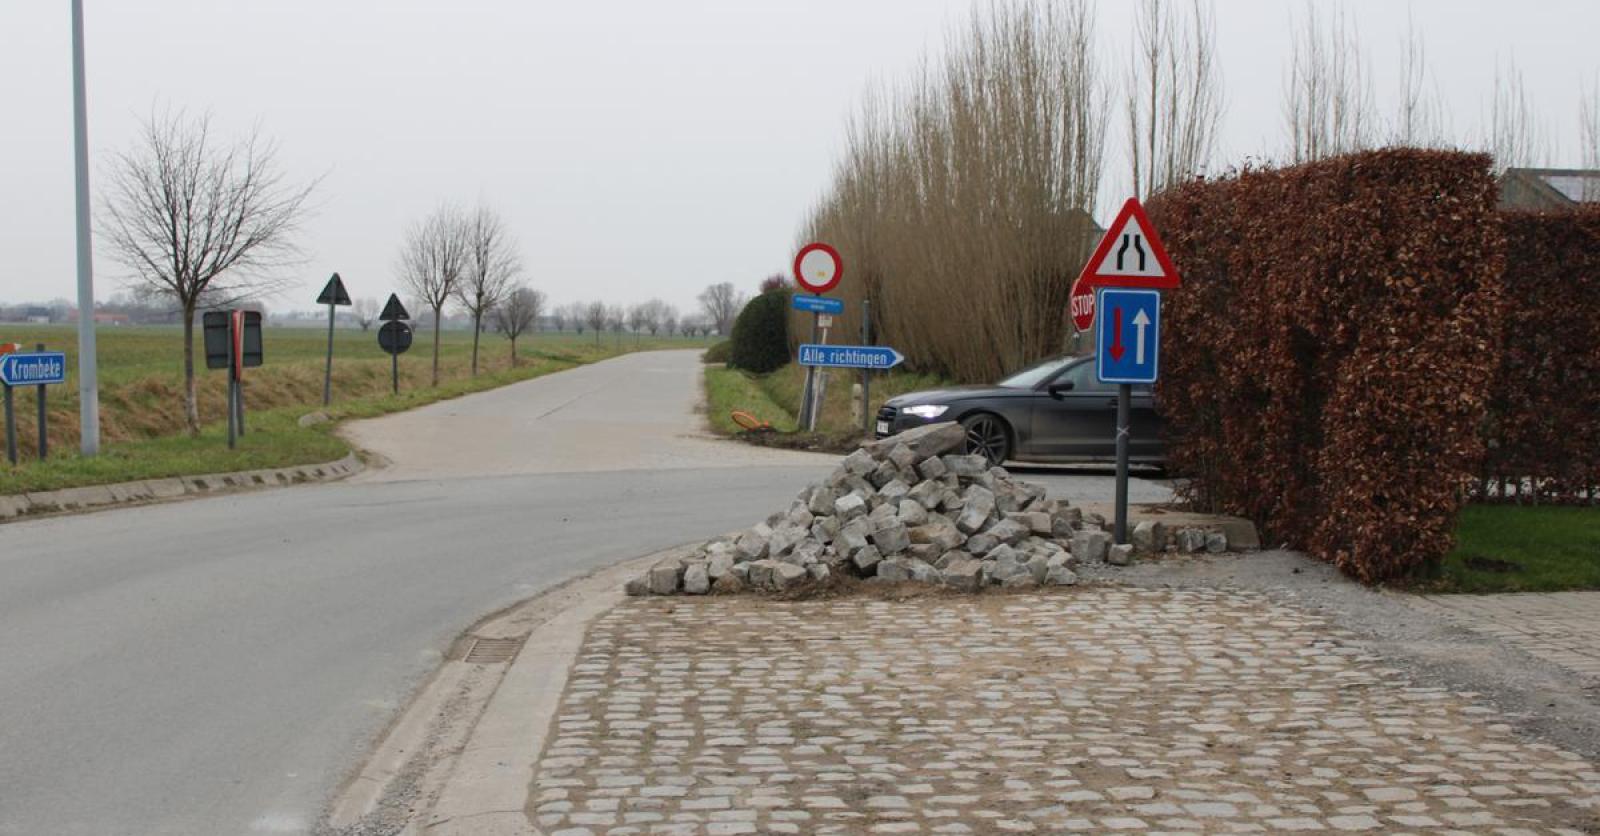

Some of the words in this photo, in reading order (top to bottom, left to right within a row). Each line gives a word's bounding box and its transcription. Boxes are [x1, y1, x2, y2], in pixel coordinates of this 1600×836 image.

[1072, 293, 1094, 317] STOP
[803, 347, 825, 362] Alle
[830, 349, 887, 366] richtingen
[11, 357, 60, 379] Krombeke
